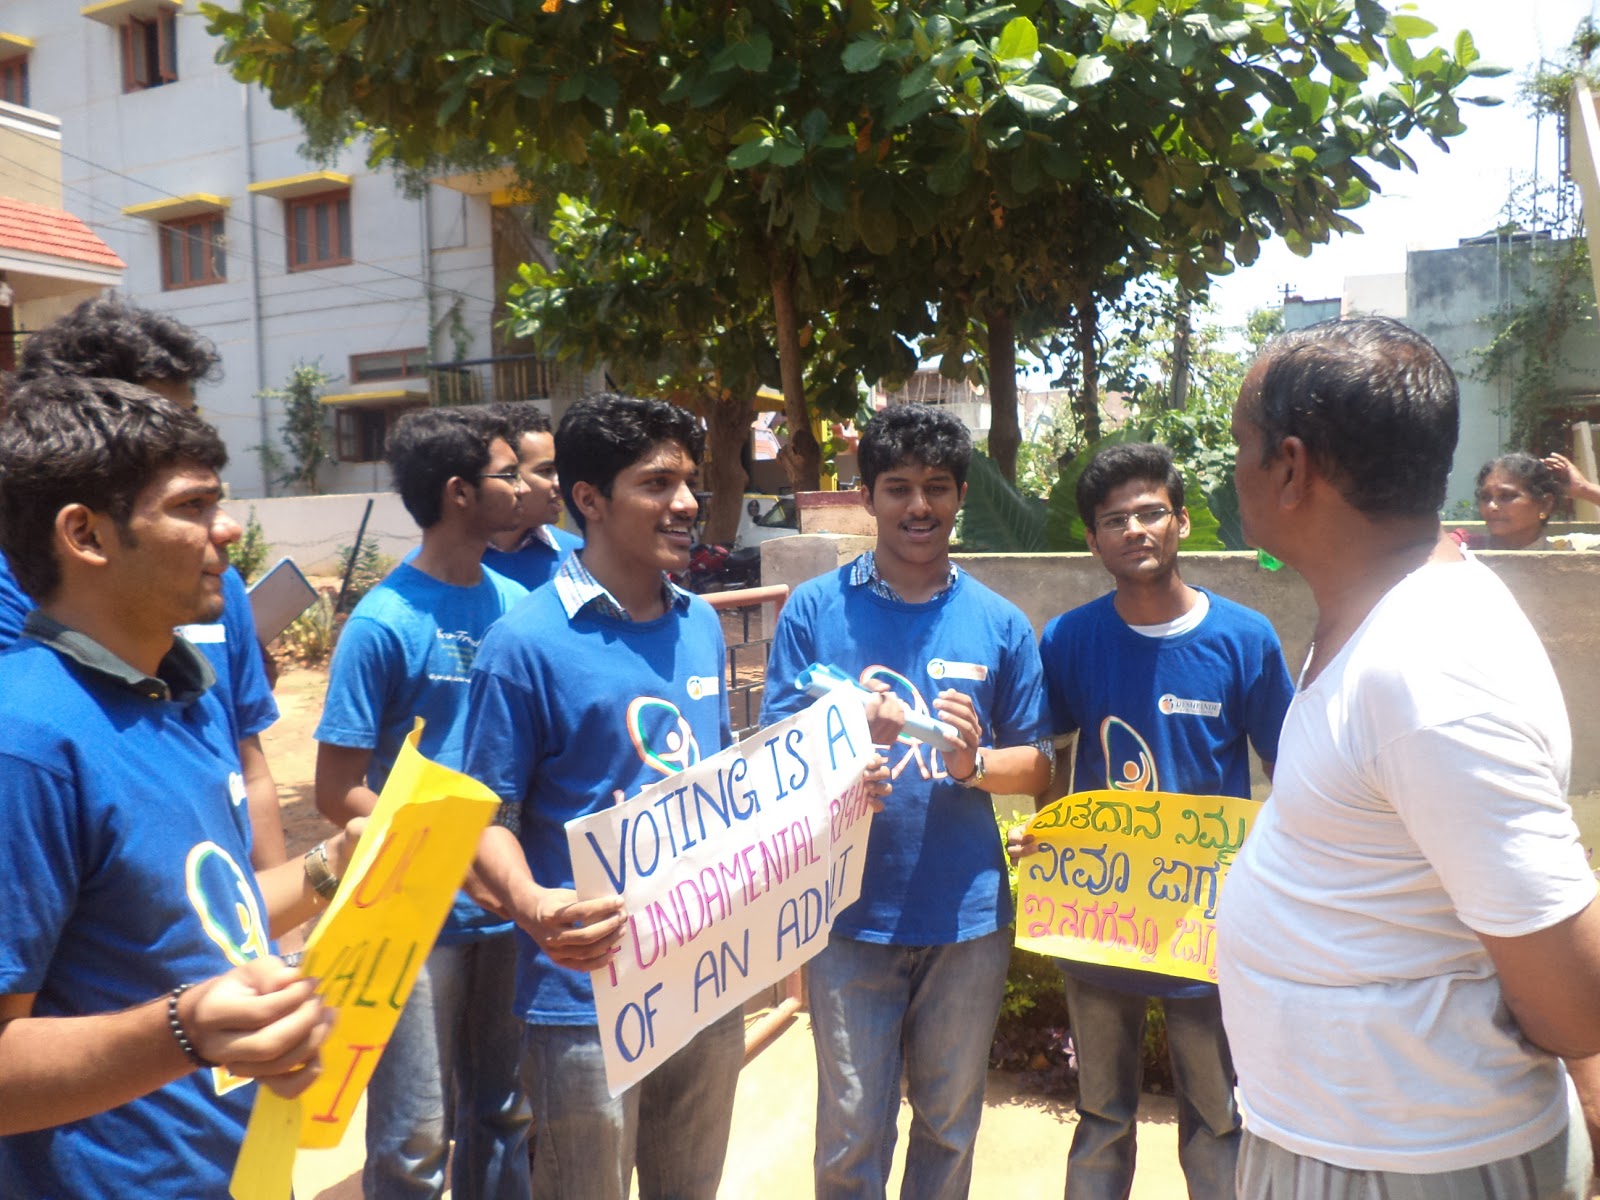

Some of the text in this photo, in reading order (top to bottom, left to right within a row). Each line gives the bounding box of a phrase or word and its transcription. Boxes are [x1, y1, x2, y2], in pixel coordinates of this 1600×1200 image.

[586, 757, 762, 895] VOTING
[765, 728, 810, 802] IS
[827, 704, 857, 771] A
[614, 982, 663, 1063] OF
[693, 929, 750, 1013] AN
